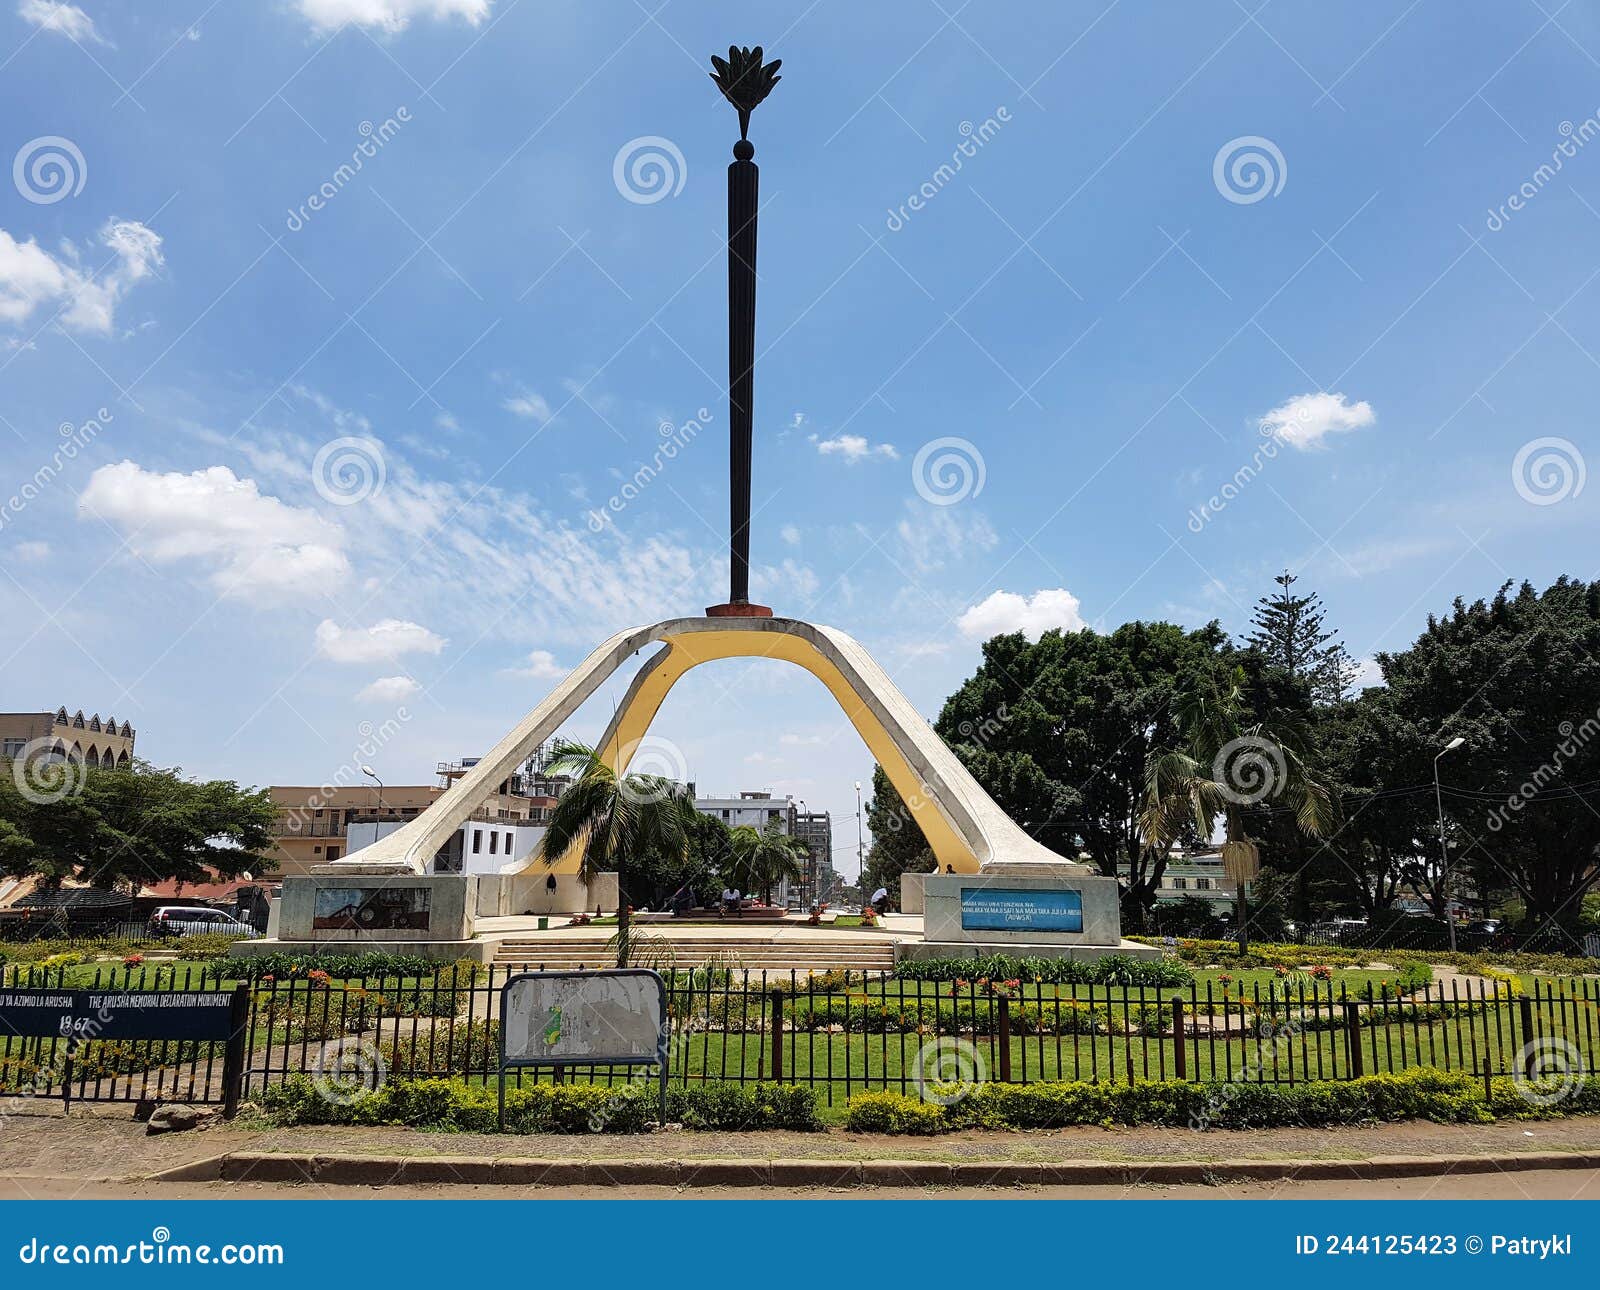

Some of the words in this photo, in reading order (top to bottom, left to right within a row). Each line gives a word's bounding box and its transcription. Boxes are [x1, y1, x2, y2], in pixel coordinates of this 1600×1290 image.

[5, 995, 13, 1006] YA
[36, 996, 44, 1007] LA
[44, 996, 73, 1008] ARUSHA
[88, 996, 102, 1009] THE
[101, 996, 130, 1009] ARUSHA
